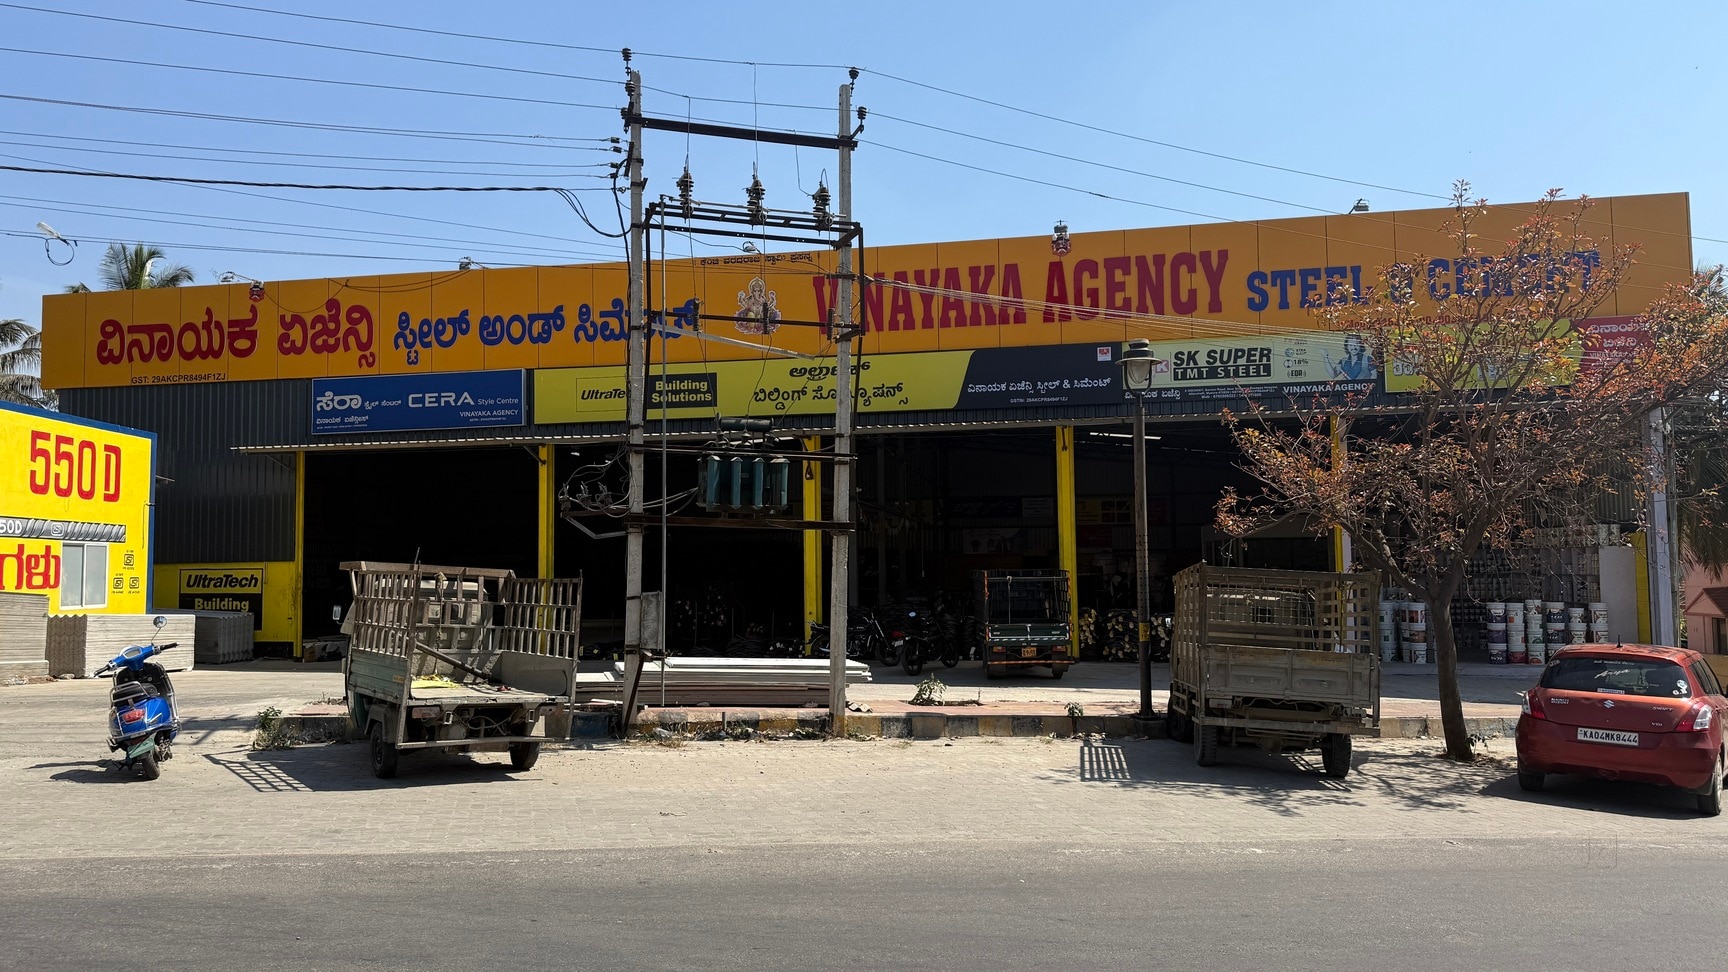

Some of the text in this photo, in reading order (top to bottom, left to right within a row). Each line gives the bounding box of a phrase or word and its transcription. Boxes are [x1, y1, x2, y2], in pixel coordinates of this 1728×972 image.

[812, 262, 1027, 335] VNAYAKA
[1042, 249, 1229, 324] AGENCY
[1246, 264, 1373, 313] STEEL
[96, 304, 260, 367] ವಿನಾಯಕ
[277, 298, 376, 369] ಏಜೆನ್ಸಿ
[393, 309, 470, 367] ಸ್ಟೀಲ್
[478, 304, 566, 346] ಅಂಡ್
[1173, 347, 1273, 367] SK SUPER
[1175, 364, 1269, 380] TMT STEEL
[130, 376, 151, 385] GST:
[655, 378, 708, 392] Building
[967, 376, 1113, 394] ವಿನಾಯಕ ಏಜೆನ್ಸಿ ಸ್ಟೀಲ್ & ಸಿಮೆಂಟ್
[1283, 384, 1333, 393] VINAYAKA
[316, 390, 363, 412] ಸೆರಾ
[408, 391, 519, 408] CERA Style Centre
[580, 387, 628, 401] UltraTe
[651, 389, 713, 404] Solutions
[754, 385, 808, 411] ಬಿಲ್ಡಿಂಗ್
[1161, 389, 1181, 400] ಏಜೆನ್ಸಿ
[316, 416, 342, 425] ವಿನಾಯಕ
[459, 410, 491, 418] VINAYAKA
[29, 430, 96, 501] 550
[186, 573, 259, 589] UltraTech
[194, 597, 250, 613] Building
[1583, 728, 1638, 745] KA04MK8444
